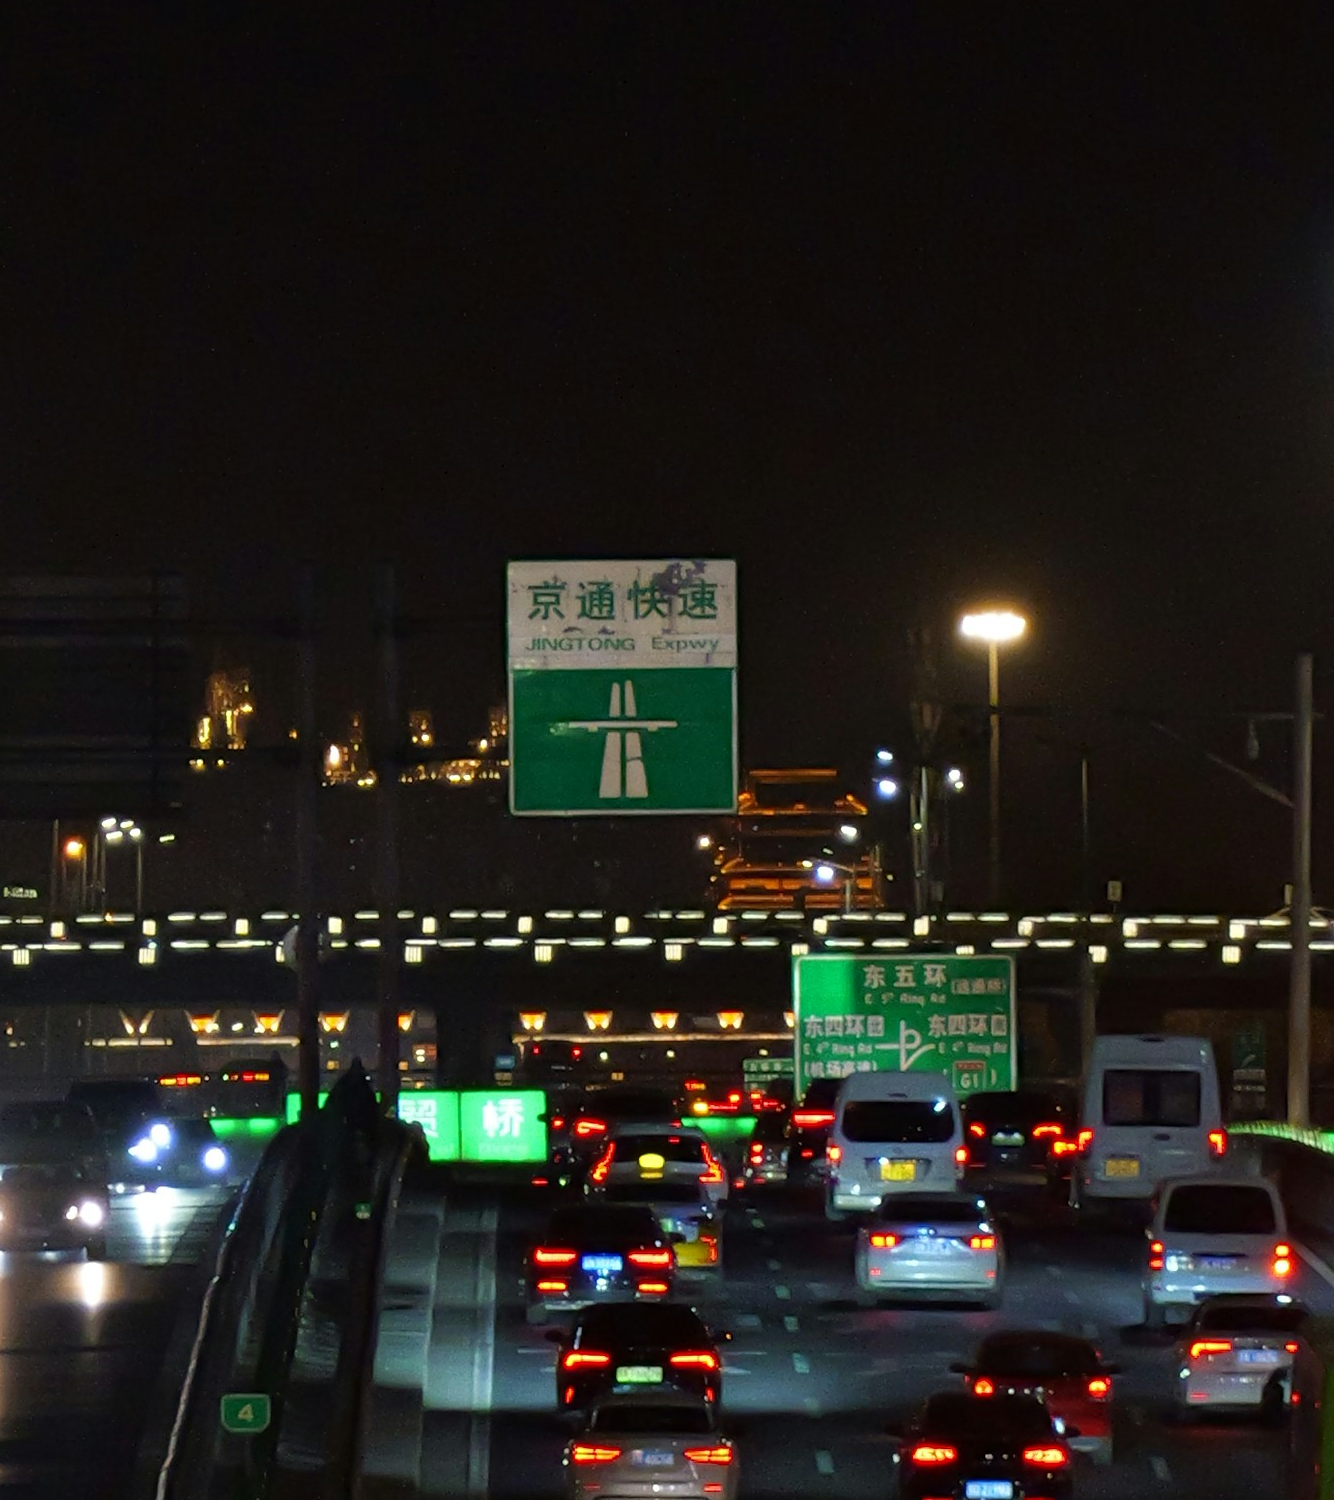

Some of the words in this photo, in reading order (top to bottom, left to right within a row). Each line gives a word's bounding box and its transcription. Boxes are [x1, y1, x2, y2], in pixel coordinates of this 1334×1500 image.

[527, 579, 718, 620] 京通快速
[525, 637, 636, 651] JINGTONG
[651, 637, 721, 653] Expwy
[863, 964, 947, 989] 东五环
[899, 993, 926, 1007] Ring
[930, 993, 947, 1004] Rd
[237, 1403, 254, 1422] 4
